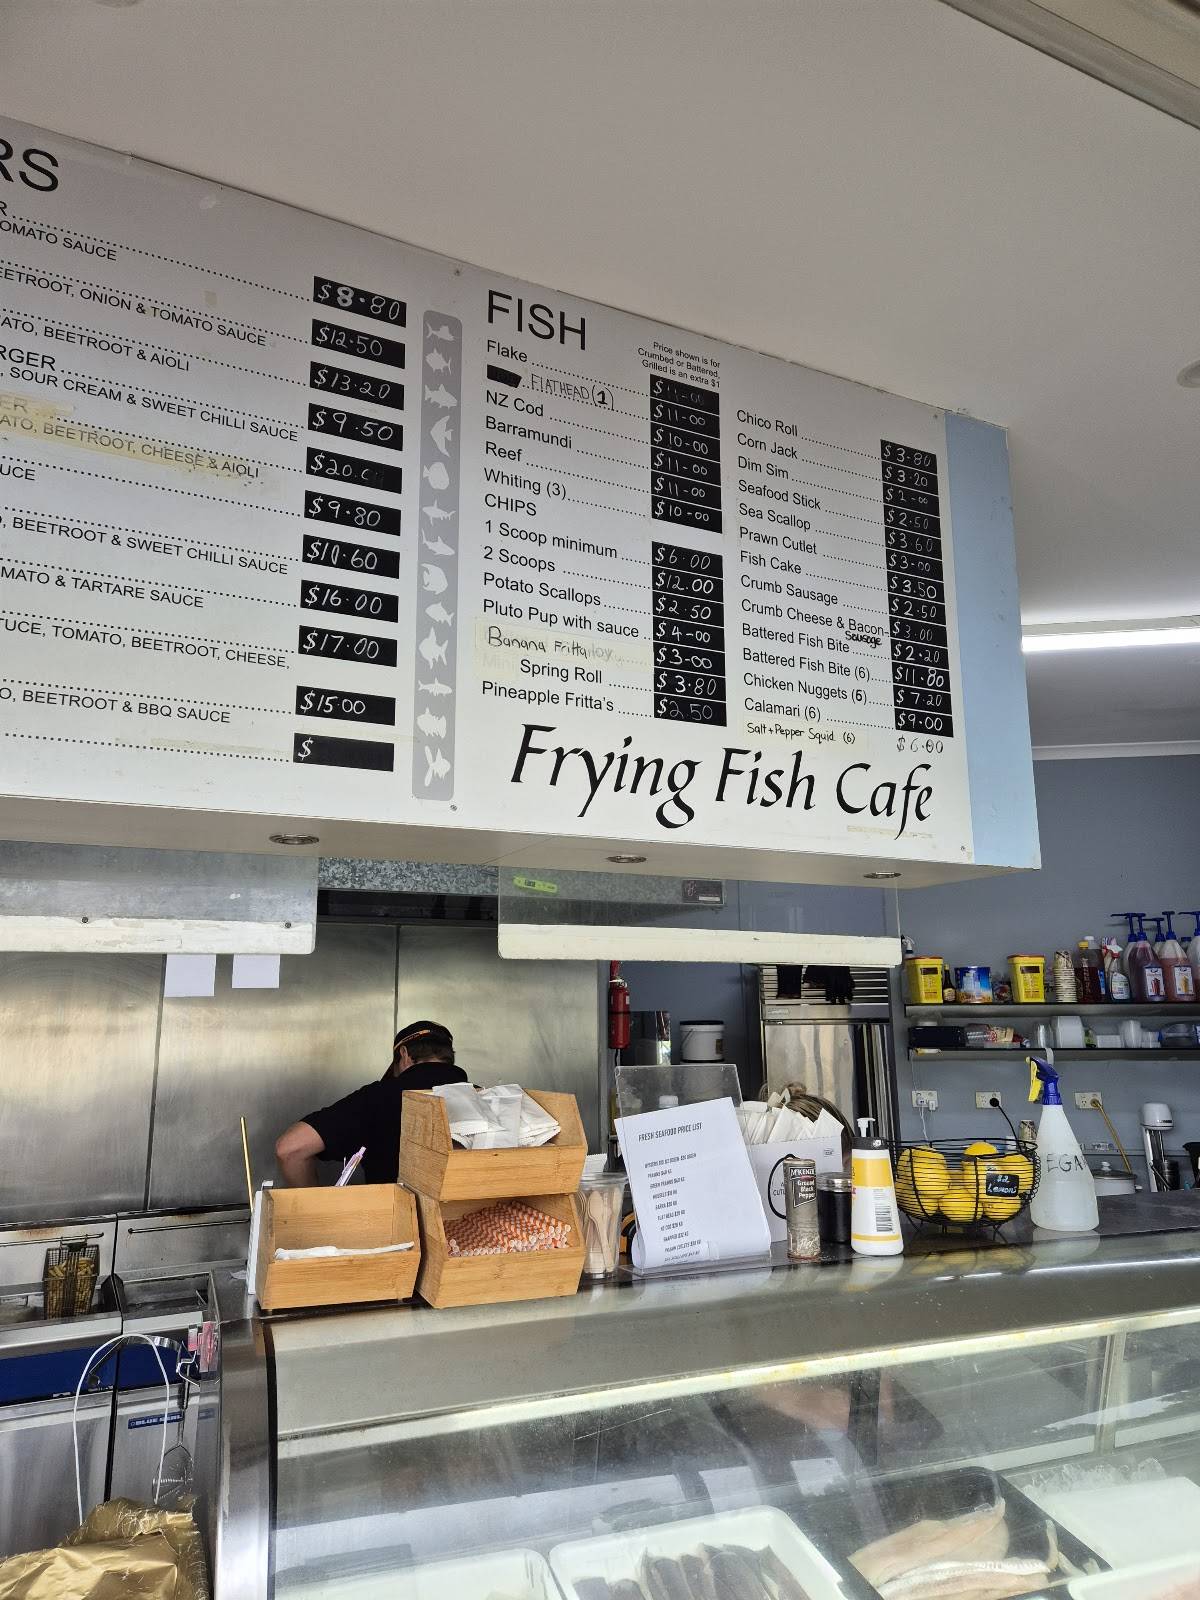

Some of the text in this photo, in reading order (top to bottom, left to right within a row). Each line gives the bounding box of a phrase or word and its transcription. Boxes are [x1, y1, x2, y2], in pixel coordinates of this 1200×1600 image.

[62, 235, 117, 261] SAUCE
[317, 281, 401, 320] $8.80
[80, 288, 266, 346] ONION & TOMATO SAUCE
[488, 289, 586, 351] FISH
[44, 326, 133, 361] BEETROOT
[137, 349, 146, 360] &
[150, 351, 190, 371] AIOLI
[315, 326, 384, 357] $12.50
[487, 339, 528, 363] Flake
[638, 347, 674, 365] Crumbed
[653, 341, 720, 368] Price shown is for
[314, 369, 391, 399] $13.20
[642, 359, 720, 388] Grilled is an extra $1
[10, 367, 298, 442] SOUR CREAM & SWEET CHILLI SAUCE
[486, 390, 544, 416] NZ Cod
[311, 410, 394, 442] $9.50
[486, 415, 573, 449] Barramundi
[736, 409, 799, 437] Chico Roll
[485, 441, 522, 462] Reef
[737, 432, 799, 460] Corn Jack
[141, 444, 204, 467] CHEESE
[207, 457, 218, 469] &
[222, 461, 259, 478] AIOLI
[738, 455, 789, 480] Dim Sim
[484, 467, 566, 500] Whiting (3)
[738, 479, 822, 511] Seafood Stick
[308, 495, 381, 527] $9.80
[484, 493, 537, 516] CHIPS
[739, 503, 811, 531] Sea Scallop
[887, 508, 929, 529] $2.50
[12, 516, 289, 576] BEETROOT & SWEET CHILLI SAUCE
[485, 520, 617, 559] 1 Scoop minimum
[739, 526, 818, 555] Prawn Cutlet
[483, 546, 555, 572] 2 Scoops
[740, 550, 802, 574] Fish Cake
[1, 566, 204, 609] MATO & TARTARE SAUCE
[483, 572, 601, 606] Potato Scallops
[655, 569, 714, 594] $12.00
[740, 574, 839, 607] Crumb Sausage
[890, 574, 937, 599] $3.50
[305, 585, 382, 614] $16.00
[655, 595, 711, 620] $2.50
[741, 598, 845, 629] Crumb Cheese &
[891, 598, 937, 619] $2.50
[483, 598, 639, 638] Pluto Pup with sauce
[52, 623, 291, 669] TOMATO, BEETROOT, CHEESE,
[302, 630, 380, 659] $17.00
[488, 625, 546, 653] Banana
[742, 622, 850, 654] Battered Fish Bite
[894, 641, 940, 662] $2.20
[520, 658, 568, 682] Spring
[574, 666, 602, 684] Roll
[743, 647, 871, 680] Battered Fish Bite (6)
[482, 680, 614, 711] Pineapple Fritta's
[657, 672, 717, 695] $3.80
[743, 672, 867, 706] Chicken Nuggets (6)
[896, 688, 943, 706] $7.20
[22, 689, 231, 724] BEETROOT & BBQ SAUCE
[744, 697, 821, 723] Calamari (6)
[897, 711, 943, 731] $9.00
[808, 727, 856, 745] Squid (6)
[511, 723, 933, 841] Frying Fish Cafe
[638, 1122, 702, 1142] FRESH SEAFOOD PRICE LIST
